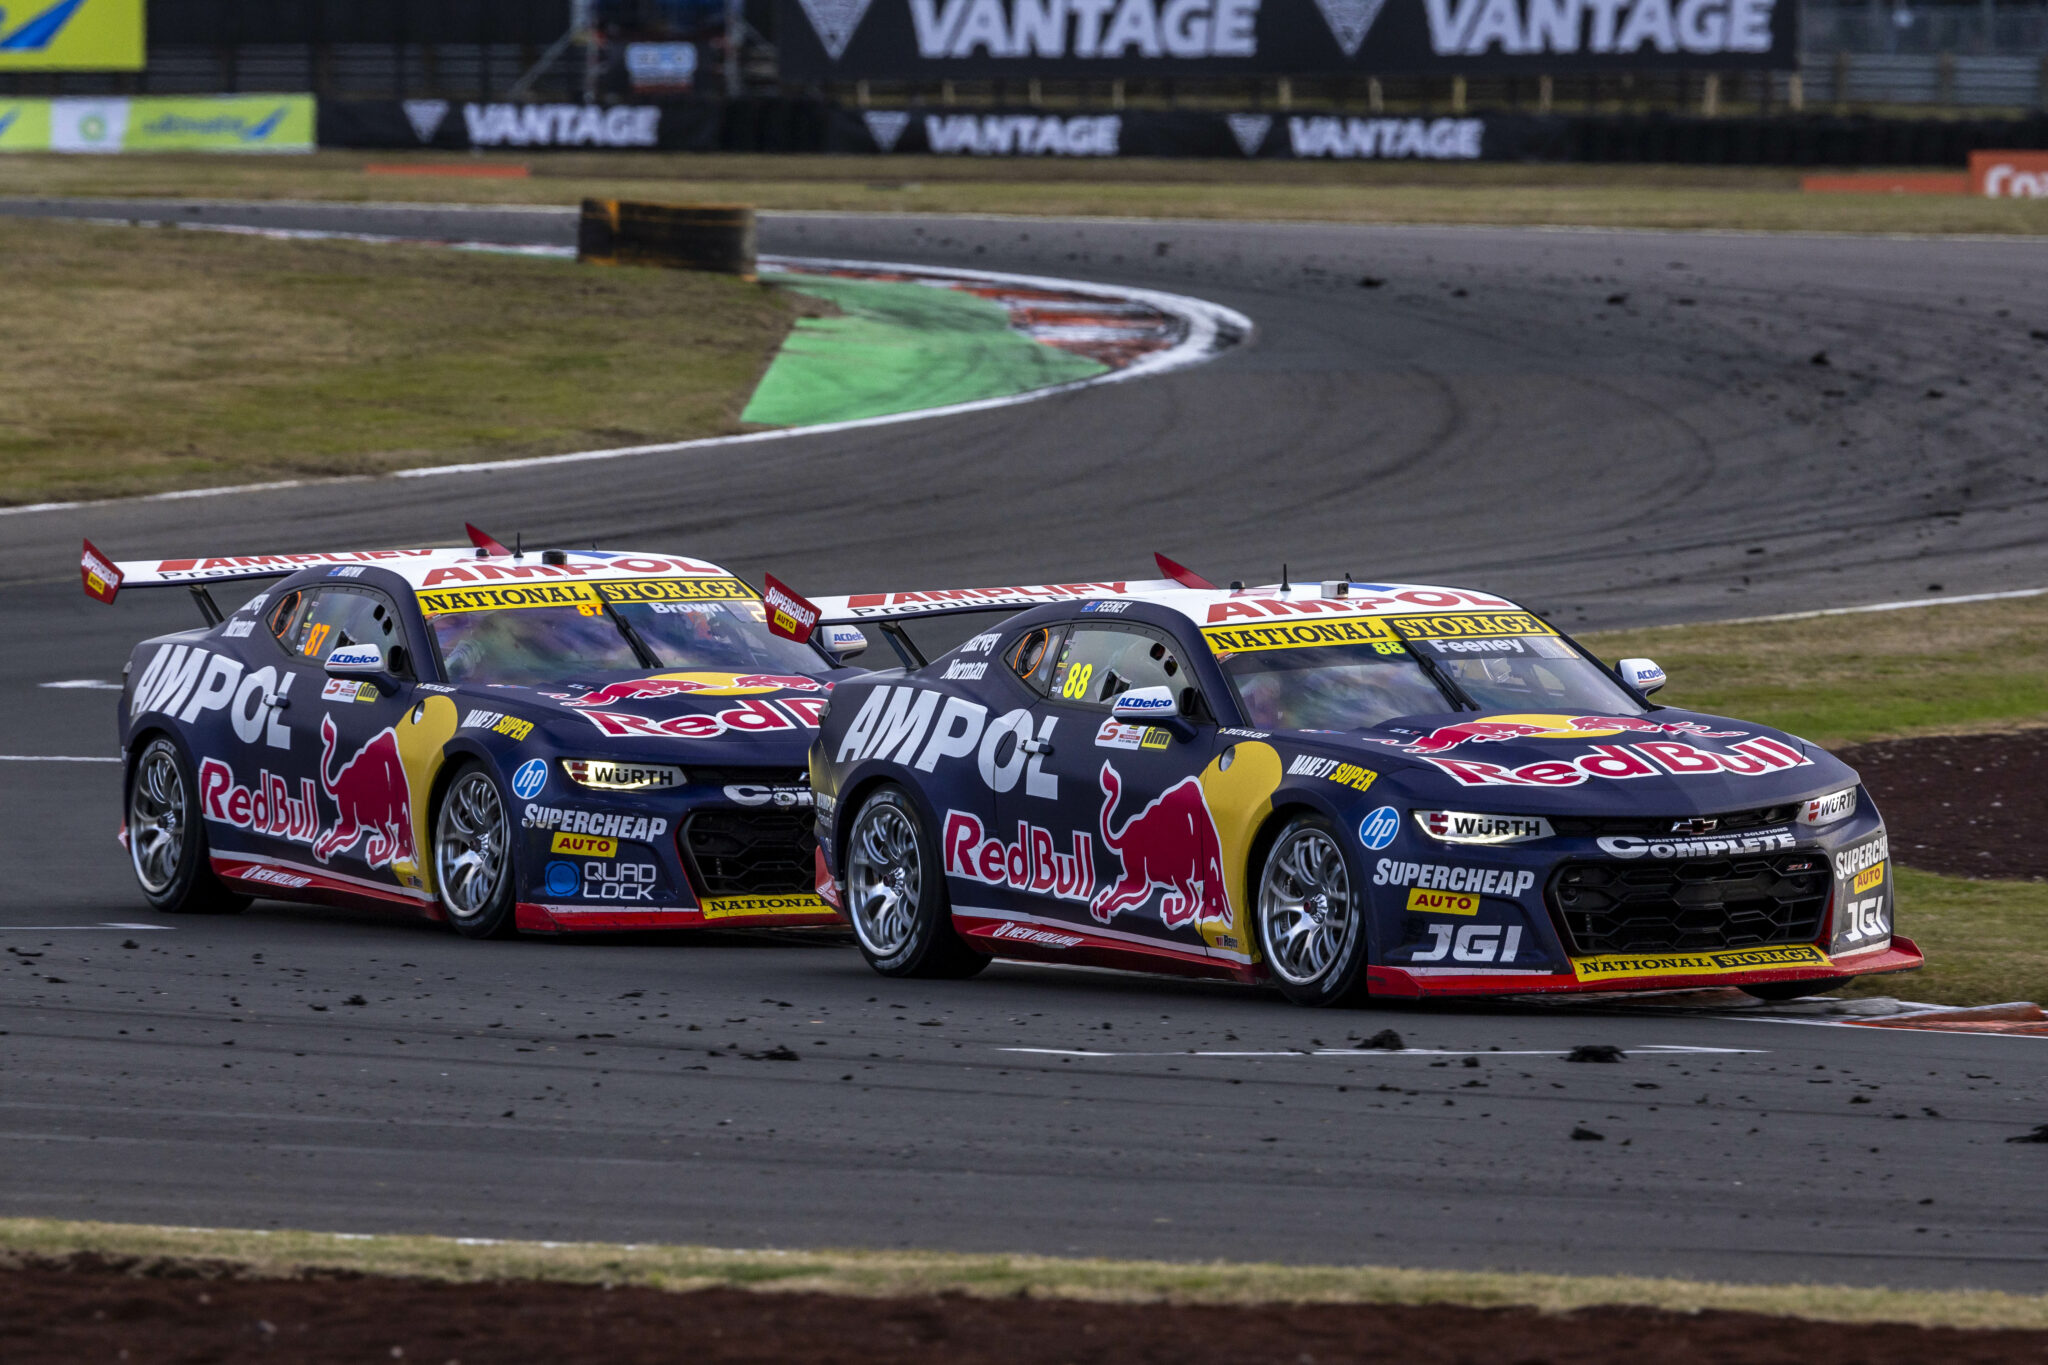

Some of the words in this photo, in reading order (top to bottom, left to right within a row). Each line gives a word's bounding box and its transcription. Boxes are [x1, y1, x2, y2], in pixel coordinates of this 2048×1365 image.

[912, 0, 1258, 57] VANTAGE
[1427, 0, 1773, 55] VANTAGE
[464, 104, 661, 146] VANTAGE
[925, 115, 1121, 155] VANTAGE
[1289, 117, 1485, 157] VANTAGE
[422, 557, 721, 586] AMPOL
[420, 586, 591, 612] NATIONAL
[600, 580, 746, 602] STORAGE
[766, 586, 815, 628] SUPERCHEAP
[892, 582, 1128, 605] AMPLIFY
[1095, 601, 1134, 614] FEENEY
[1206, 591, 1511, 623] AMPOL
[576, 603, 604, 617] 87
[648, 602, 725, 614] Brown
[776, 613, 795, 630] AUTO
[303, 623, 331, 656] 87
[1206, 621, 1385, 650] NATIONAL
[1396, 614, 1541, 638] STORAGE
[1428, 637, 1525, 654] Feeney
[328, 654, 380, 664] ACDelco
[1371, 642, 1406, 656] 88
[1063, 662, 1093, 699] 88
[130, 644, 296, 750] AMPOL
[1117, 697, 1173, 708] ACDelco
[492, 715, 535, 742] SUPER
[836, 685, 1059, 800] AMPOL
[1224, 728, 1271, 739] DUNLOP
[515, 759, 545, 798] hp
[1287, 754, 1328, 777] MAKE
[1321, 759, 1340, 779] IT
[1329, 763, 1379, 792] SUPER
[521, 803, 667, 842] SUPERCHEAP
[1363, 806, 1397, 850] hp
[558, 837, 611, 853] AUTO
[1596, 833, 1797, 859] COMPLETE
[584, 861, 657, 883] QUAD
[1373, 858, 1536, 897] SUPERCHEAP
[1857, 867, 1881, 888] AUTO
[583, 882, 656, 900] LOCK
[1414, 893, 1472, 910] AUTO
[1845, 895, 1888, 942] JGI
[1005, 927, 1038, 940] NEW
[1029, 931, 1085, 947] HOLLAND
[1411, 923, 1523, 962] JGI
[1582, 957, 1712, 975] NATIONAL
[1719, 947, 1818, 967] STORAGE
